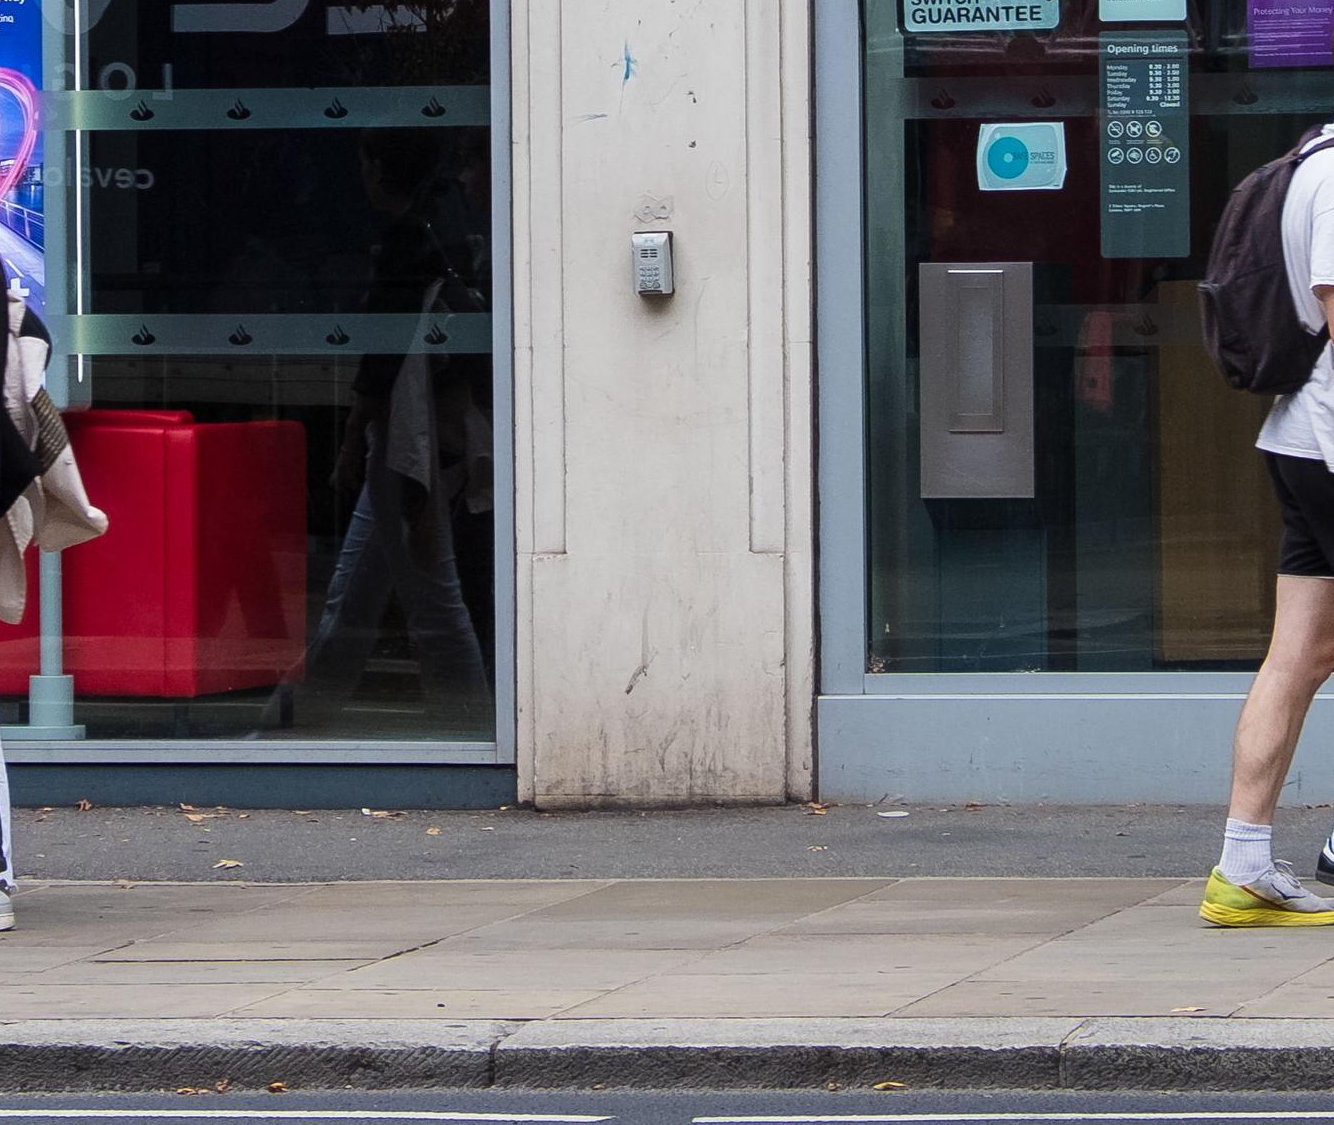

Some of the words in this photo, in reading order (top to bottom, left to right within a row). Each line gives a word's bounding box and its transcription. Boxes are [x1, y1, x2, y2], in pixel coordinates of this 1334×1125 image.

[911, 5, 1043, 25] GUARANTEE
[1253, 8, 1290, 16] Protecting
[1308, 6, 1333, 14] Money
[1107, 44, 1149, 55] Opening
[1151, 43, 1179, 53] times
